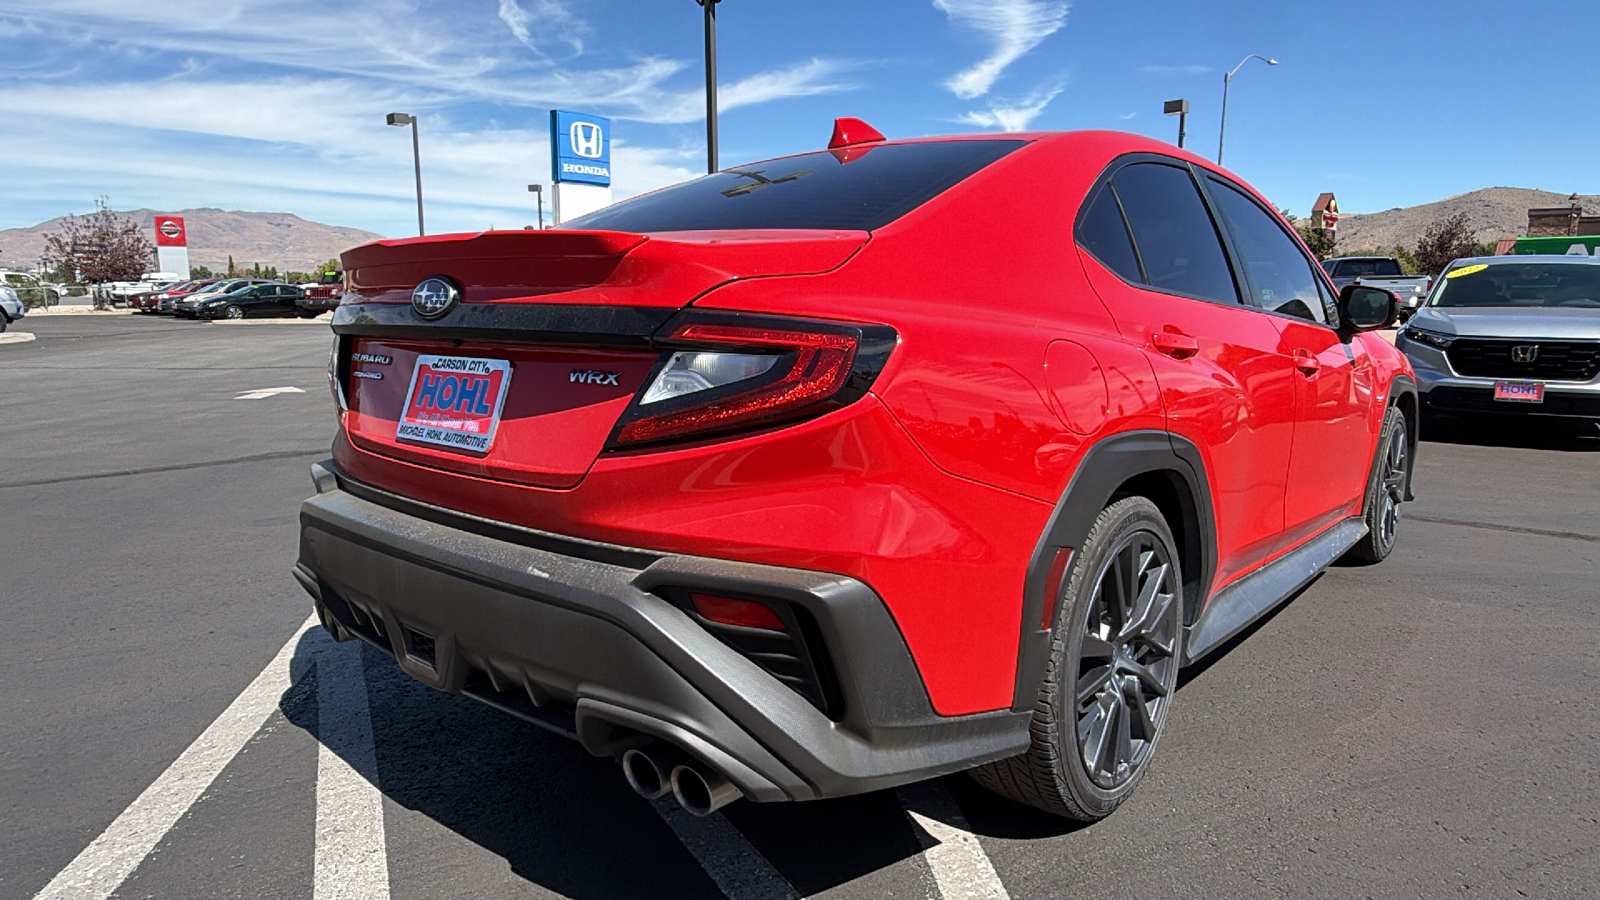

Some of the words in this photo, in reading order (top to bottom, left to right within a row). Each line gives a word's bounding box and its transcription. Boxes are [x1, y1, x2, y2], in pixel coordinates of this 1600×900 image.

[562, 163, 610, 177] HONDA
[352, 353, 391, 364] SUBARU
[437, 358, 468, 371] CARSON
[469, 360, 488, 373] CITY
[569, 370, 622, 386] WRX
[415, 373, 491, 416] HOHL
[399, 425, 425, 438] MICHAEL
[425, 429, 443, 441] HOHL
[443, 433, 488, 449] AUTOMOTIVE
